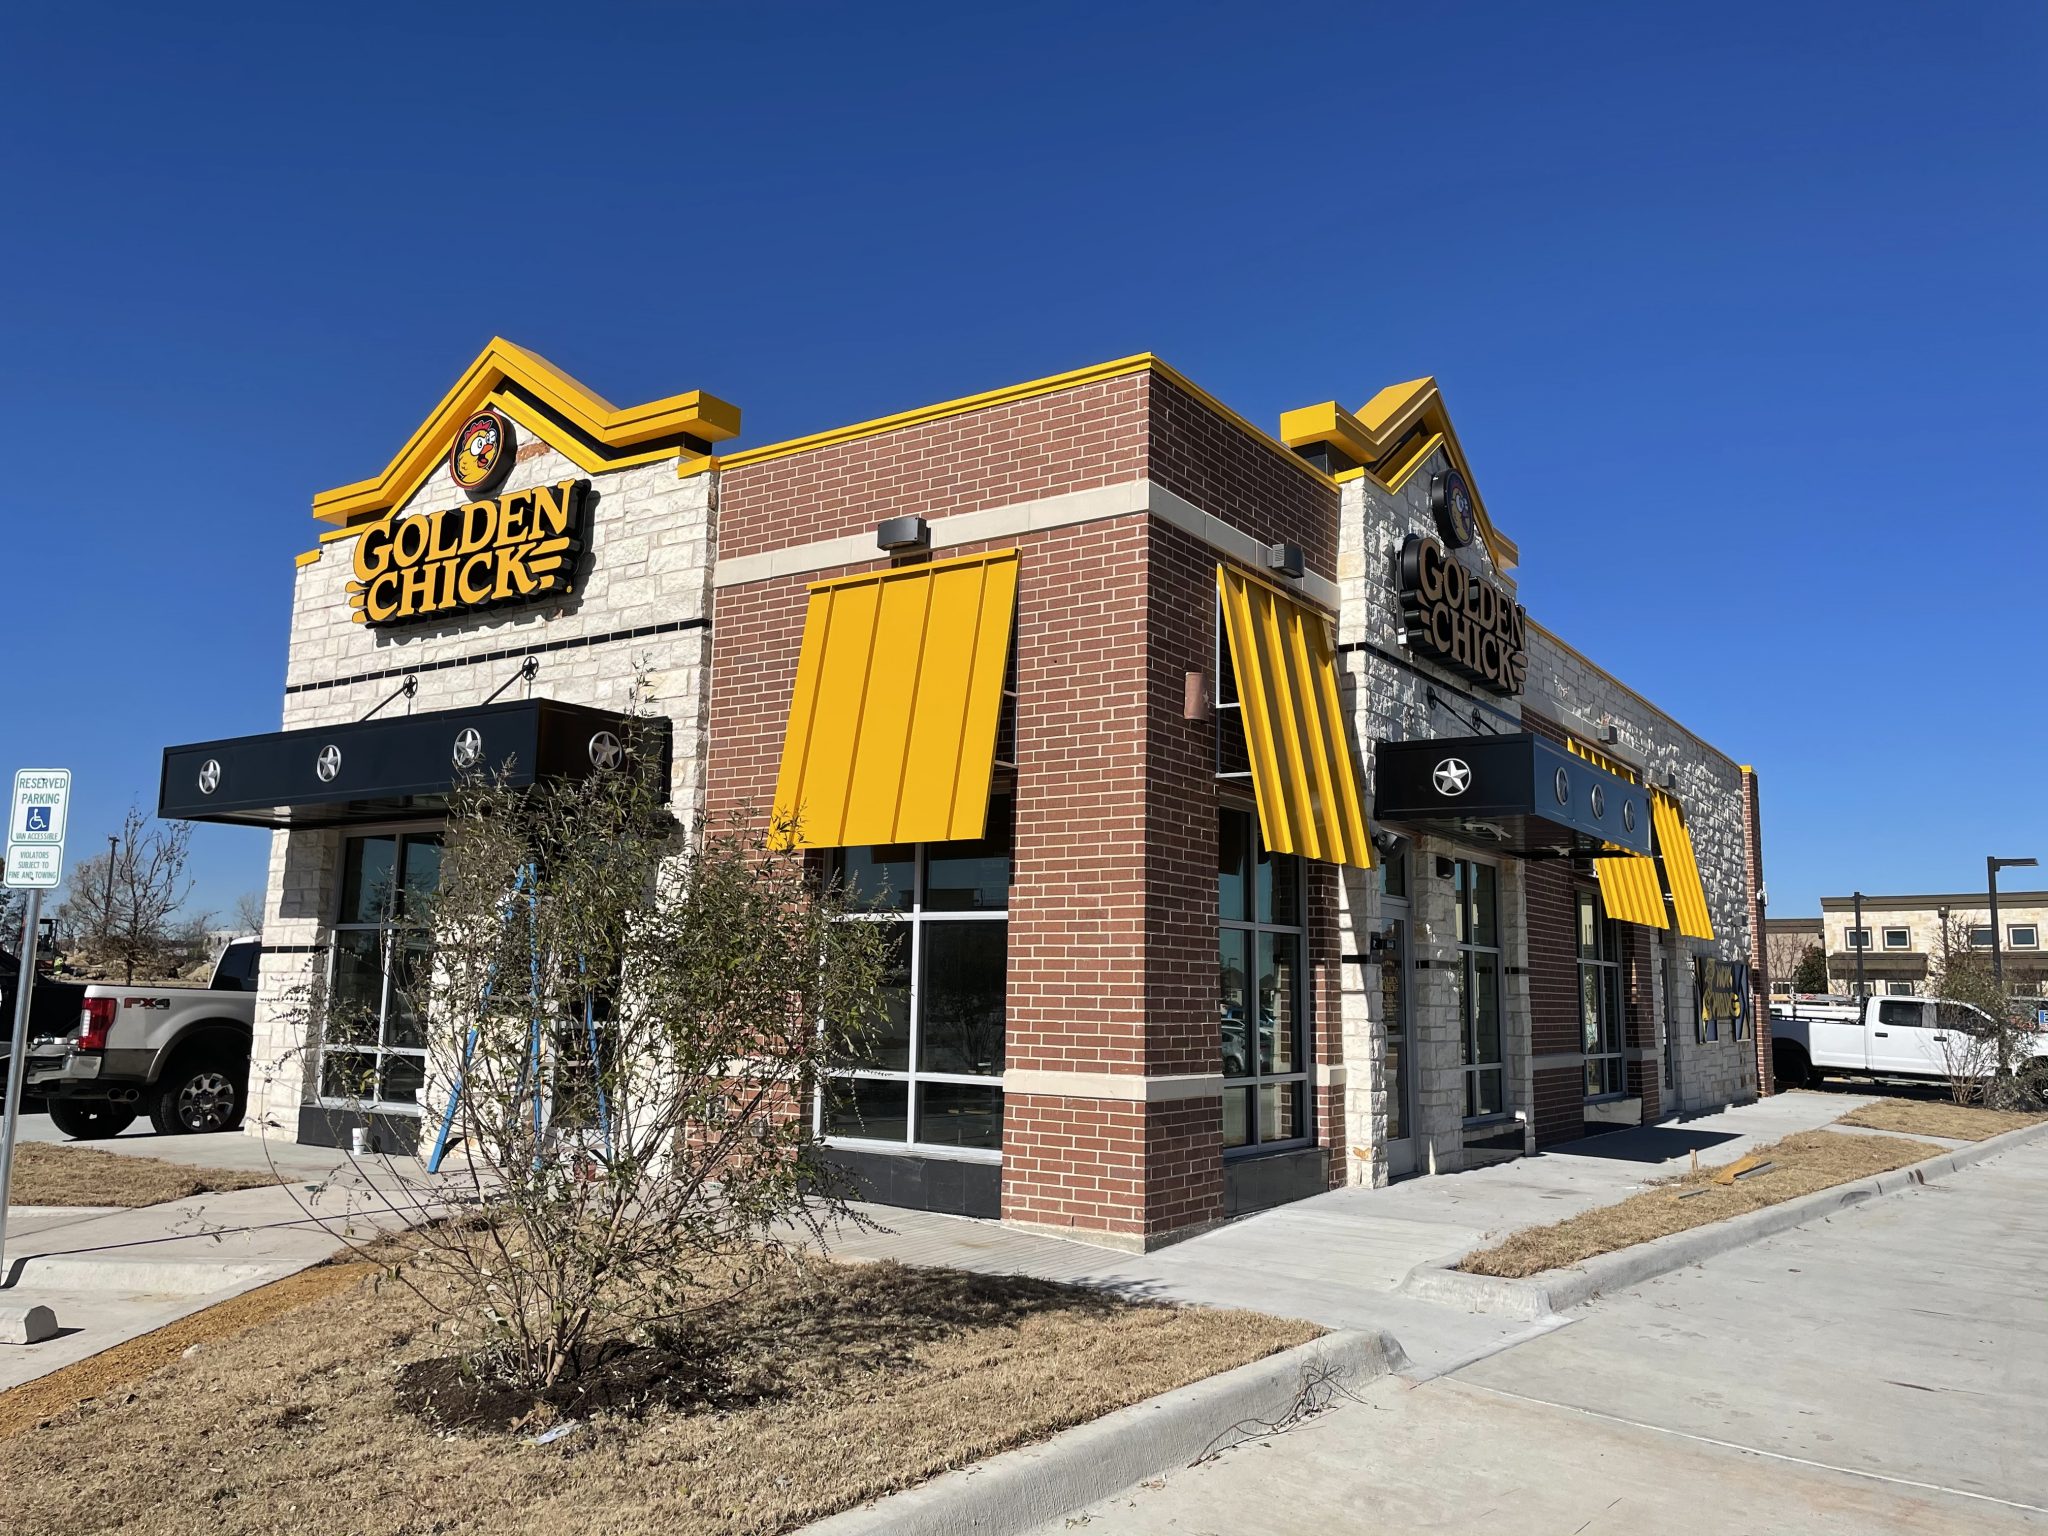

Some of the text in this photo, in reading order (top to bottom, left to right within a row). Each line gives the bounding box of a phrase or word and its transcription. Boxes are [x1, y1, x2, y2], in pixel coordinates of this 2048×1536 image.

[353, 478, 576, 582] GOLDEN
[367, 541, 540, 622] CHICK
[1419, 537, 1526, 651] GOLDEN
[1432, 601, 1518, 692] CHICK
[19, 777, 66, 789] RESERVED
[21, 793, 60, 805] PARKING
[15, 832, 58, 840] VAN ACCESSIBLE
[20, 851, 49, 859] VIOLATORS
[17, 861, 49, 869] SUBJECT TO
[8, 871, 56, 879] FINE AND TOWING
[124, 997, 171, 1010] FX4
